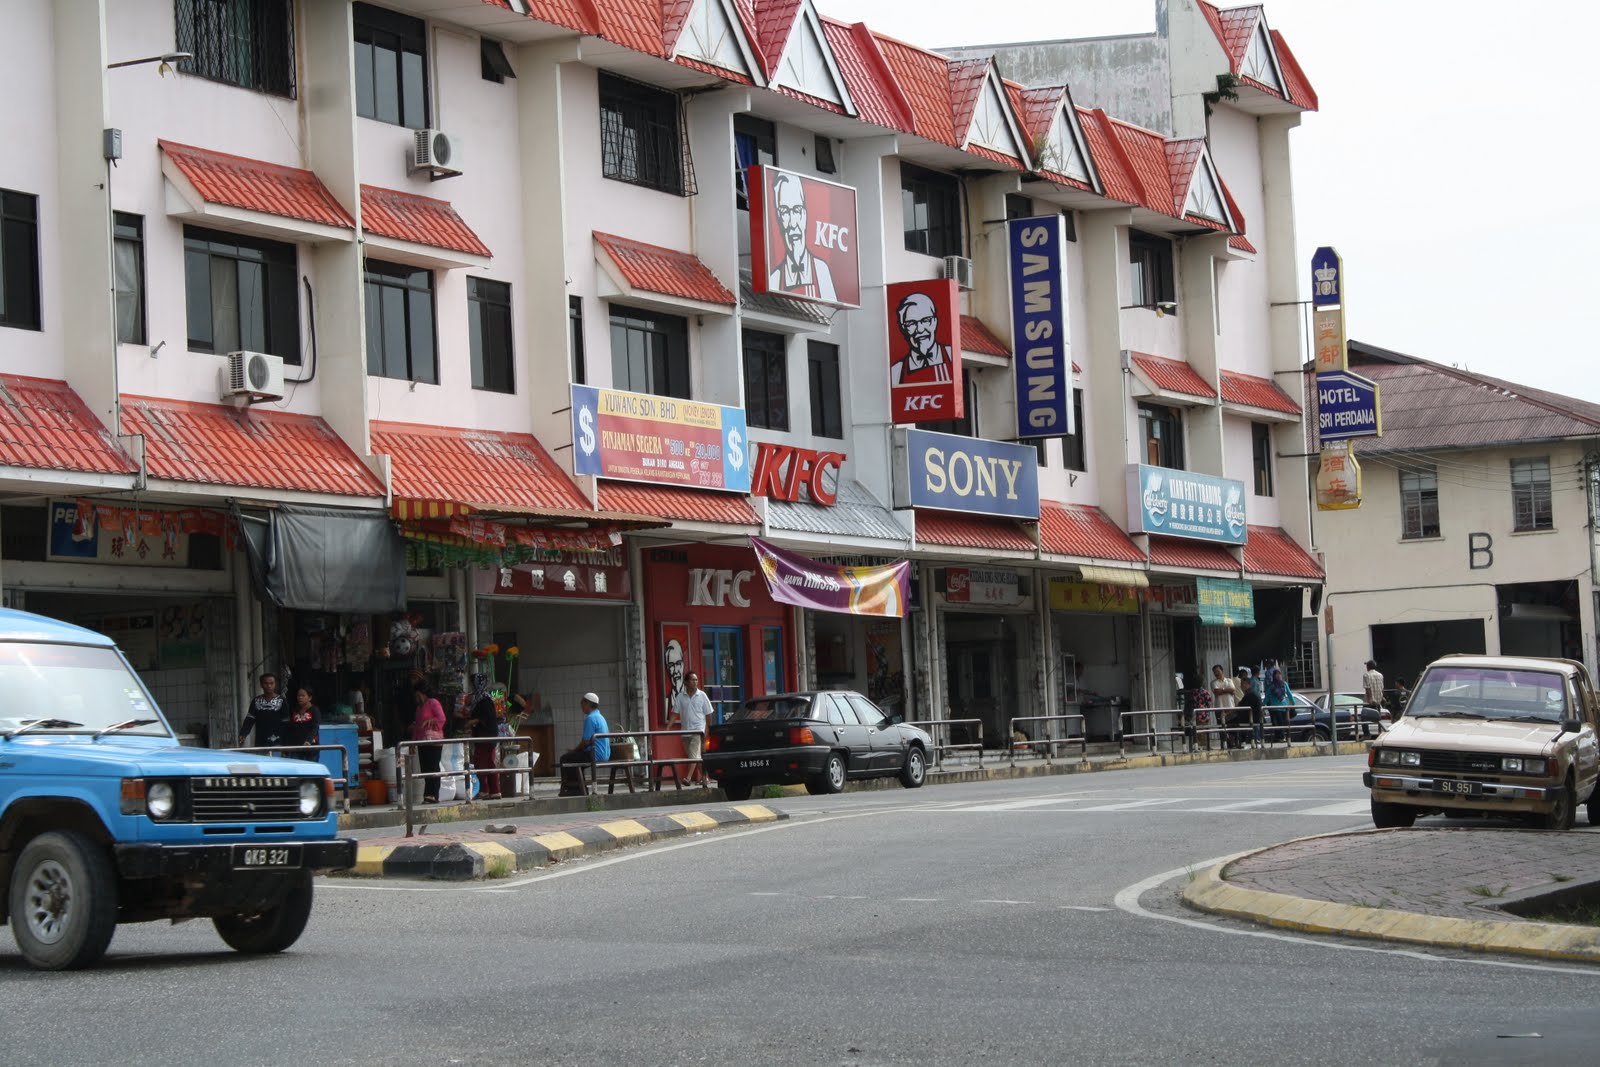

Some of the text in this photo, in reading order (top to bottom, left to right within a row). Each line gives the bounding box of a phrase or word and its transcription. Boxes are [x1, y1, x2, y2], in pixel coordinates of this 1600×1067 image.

[814, 220, 849, 252] KFC
[1021, 226, 1057, 428] SAMSUNG
[604, 393, 679, 420] YUWANG SDN. BHD.
[903, 394, 944, 412] KFC
[1319, 388, 1360, 405] HOTEL
[1319, 408, 1375, 429] SRI PERDANA
[602, 430, 635, 453] PINJAMAN
[636, 433, 663, 455] SEGERA
[751, 441, 848, 507] KFC
[924, 446, 1022, 501] SONY
[1143, 487, 1169, 516] Carlsberg
[1468, 532, 1494, 570] B
[687, 568, 756, 608] KFC
[783, 573, 803, 587] HANYA
[740, 760, 748, 768] SA
[205, 778, 289, 787] MITSUBISHI
[1442, 781, 1473, 794] SL 951
[269, 849, 289, 865] 321
